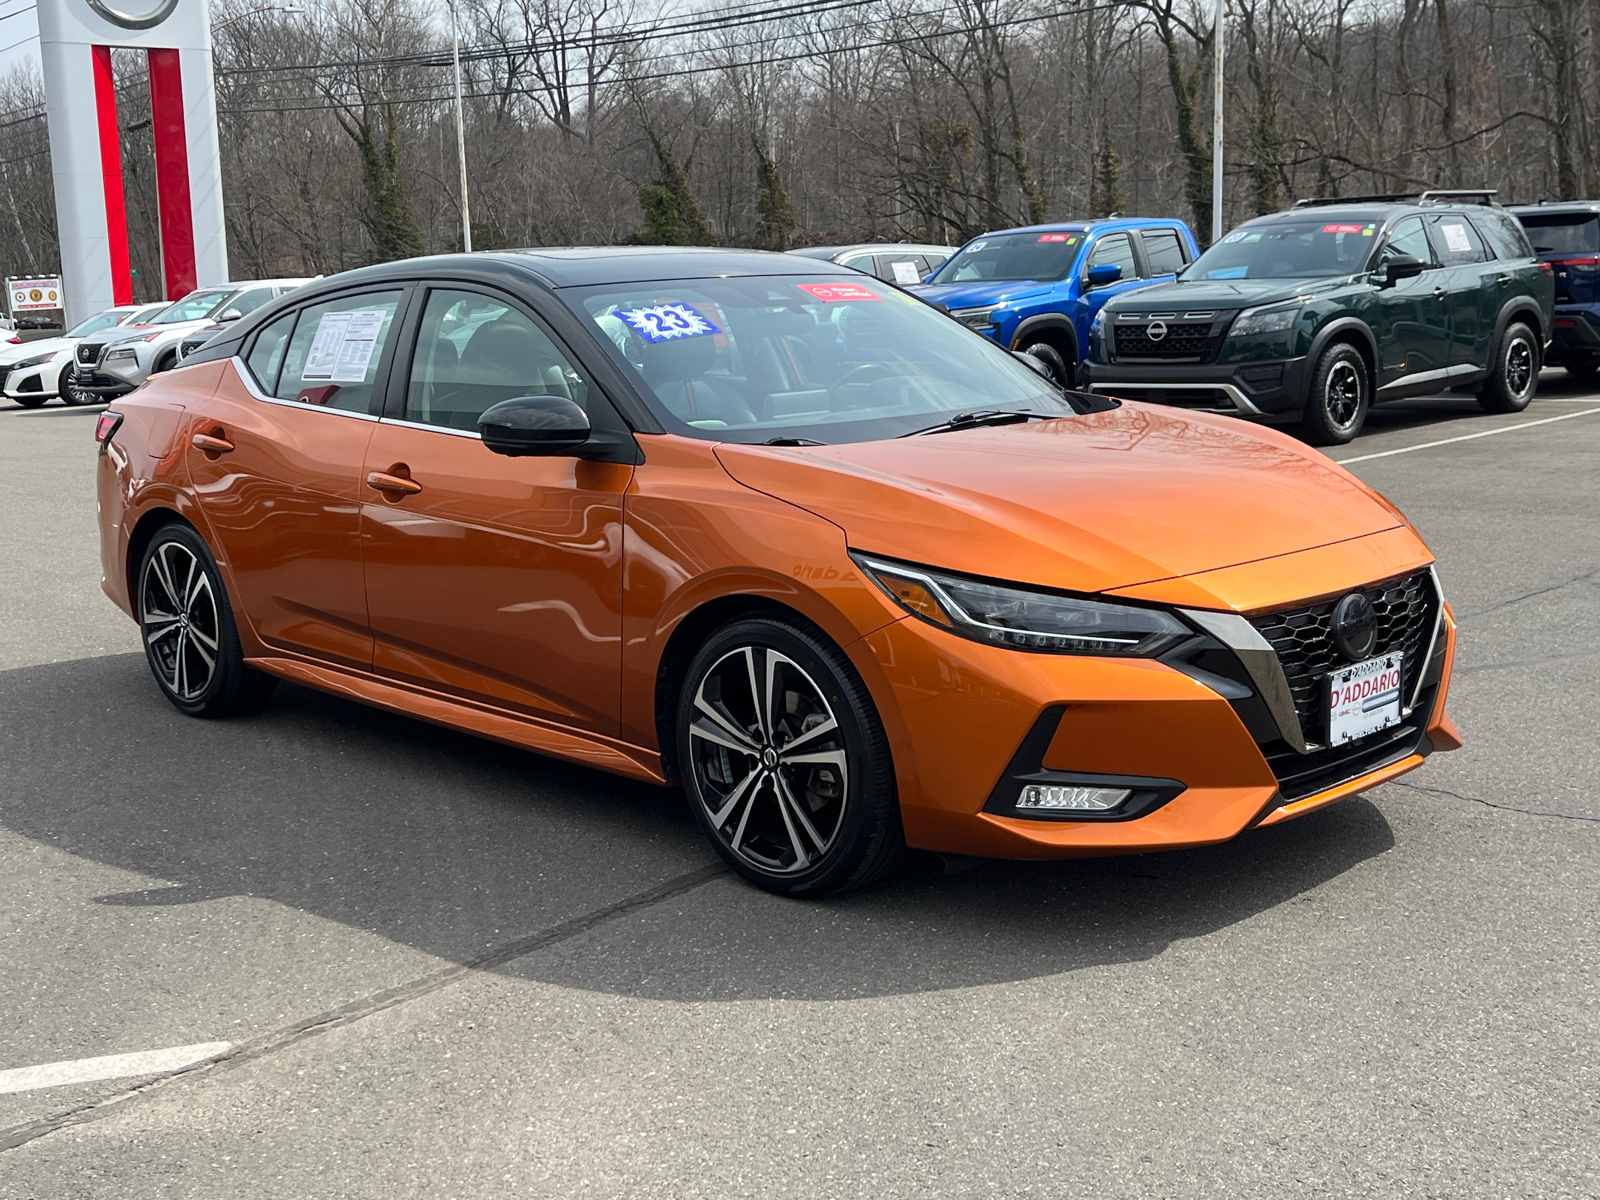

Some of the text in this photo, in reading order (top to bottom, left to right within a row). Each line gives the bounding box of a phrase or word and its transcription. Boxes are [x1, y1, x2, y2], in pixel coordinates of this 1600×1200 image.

[644, 310, 690, 332] 23
[1331, 669, 1400, 708] D'ADDARIO
[1339, 708, 1351, 717] GMC
